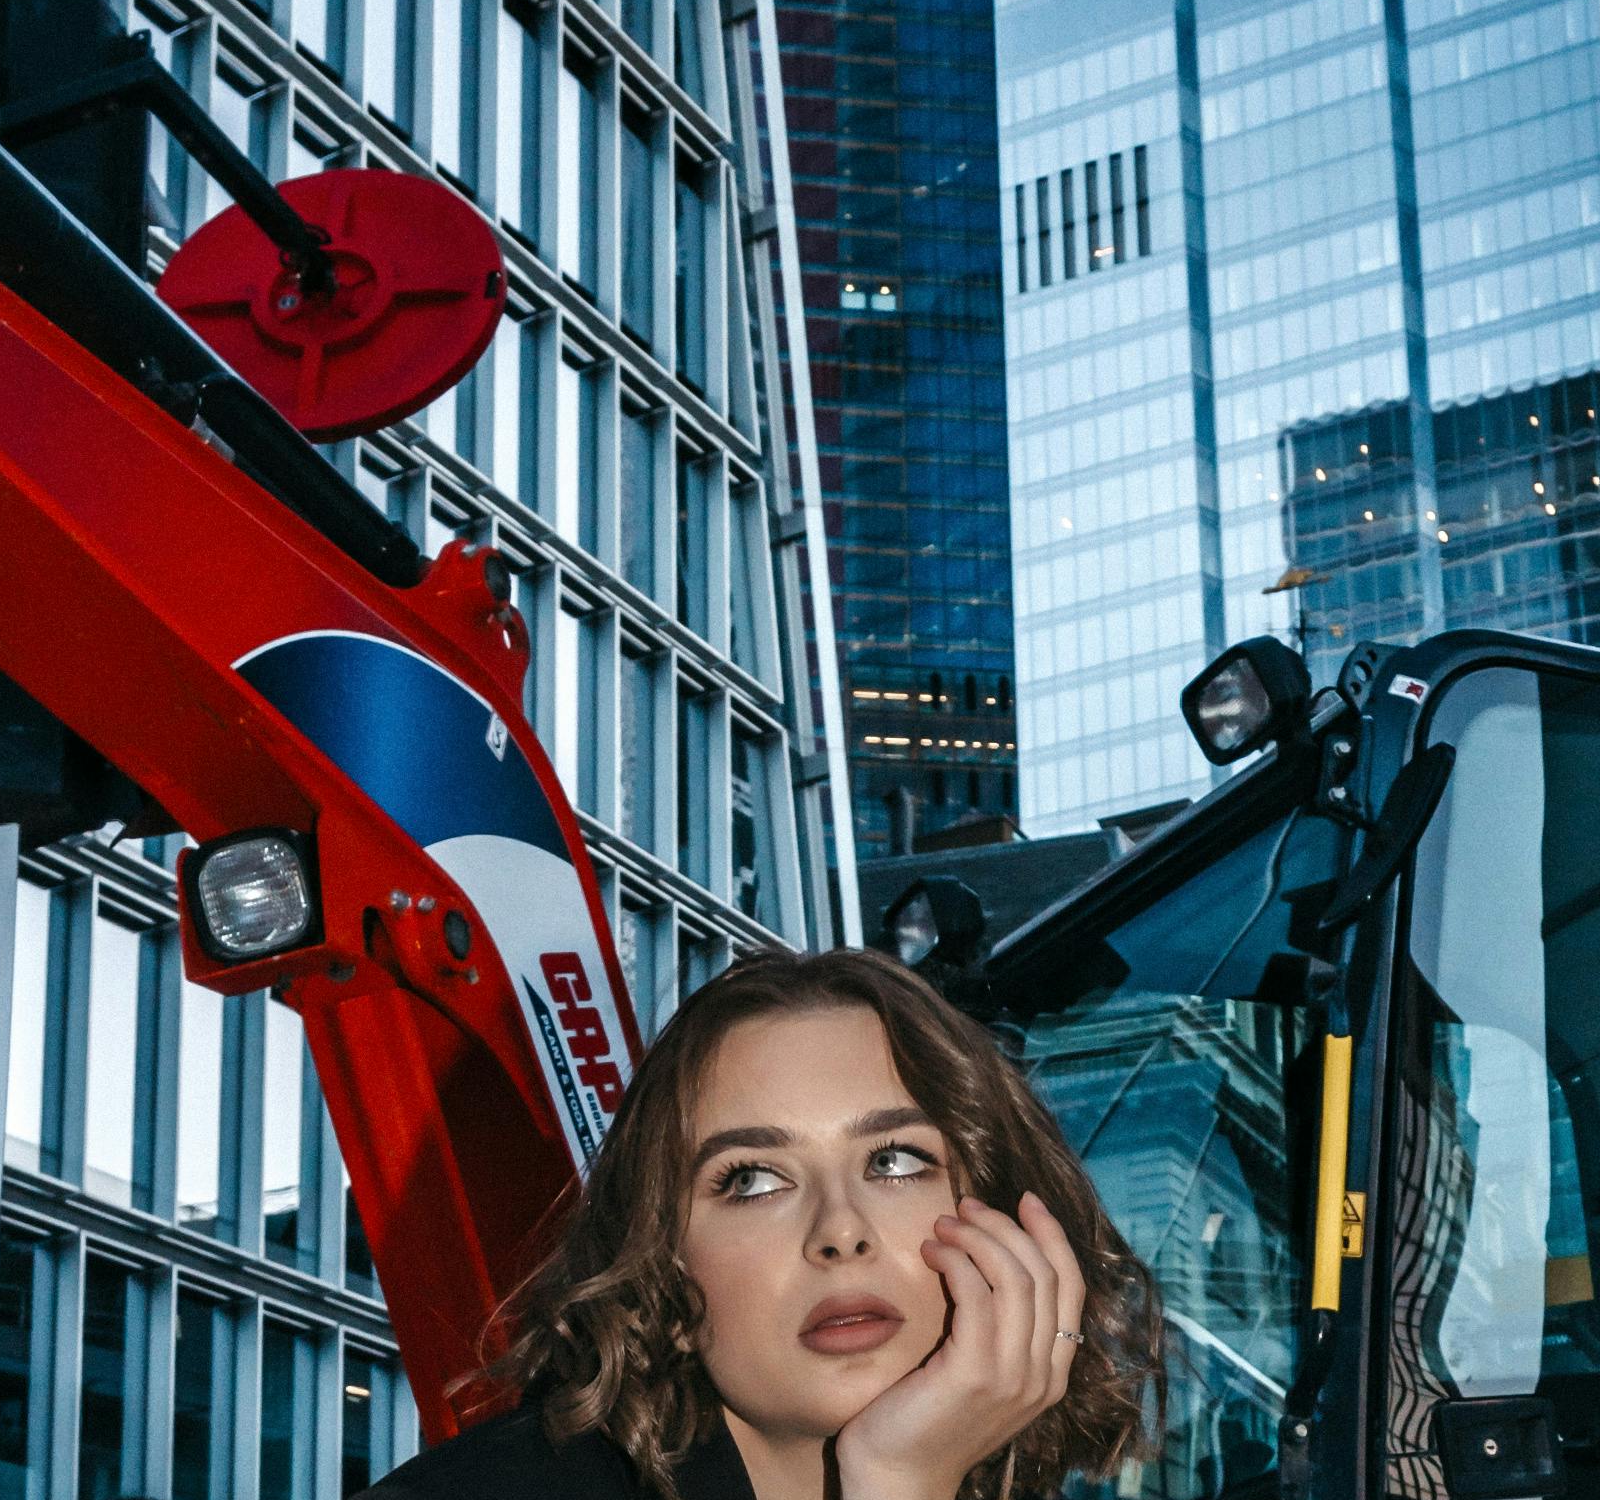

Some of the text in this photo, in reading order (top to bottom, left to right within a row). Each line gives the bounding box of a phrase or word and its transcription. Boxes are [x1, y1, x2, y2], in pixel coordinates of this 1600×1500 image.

[539, 951, 626, 1114] GAP
[540, 1013, 565, 1067] PLANT
[564, 1091, 584, 1131] TOOL
